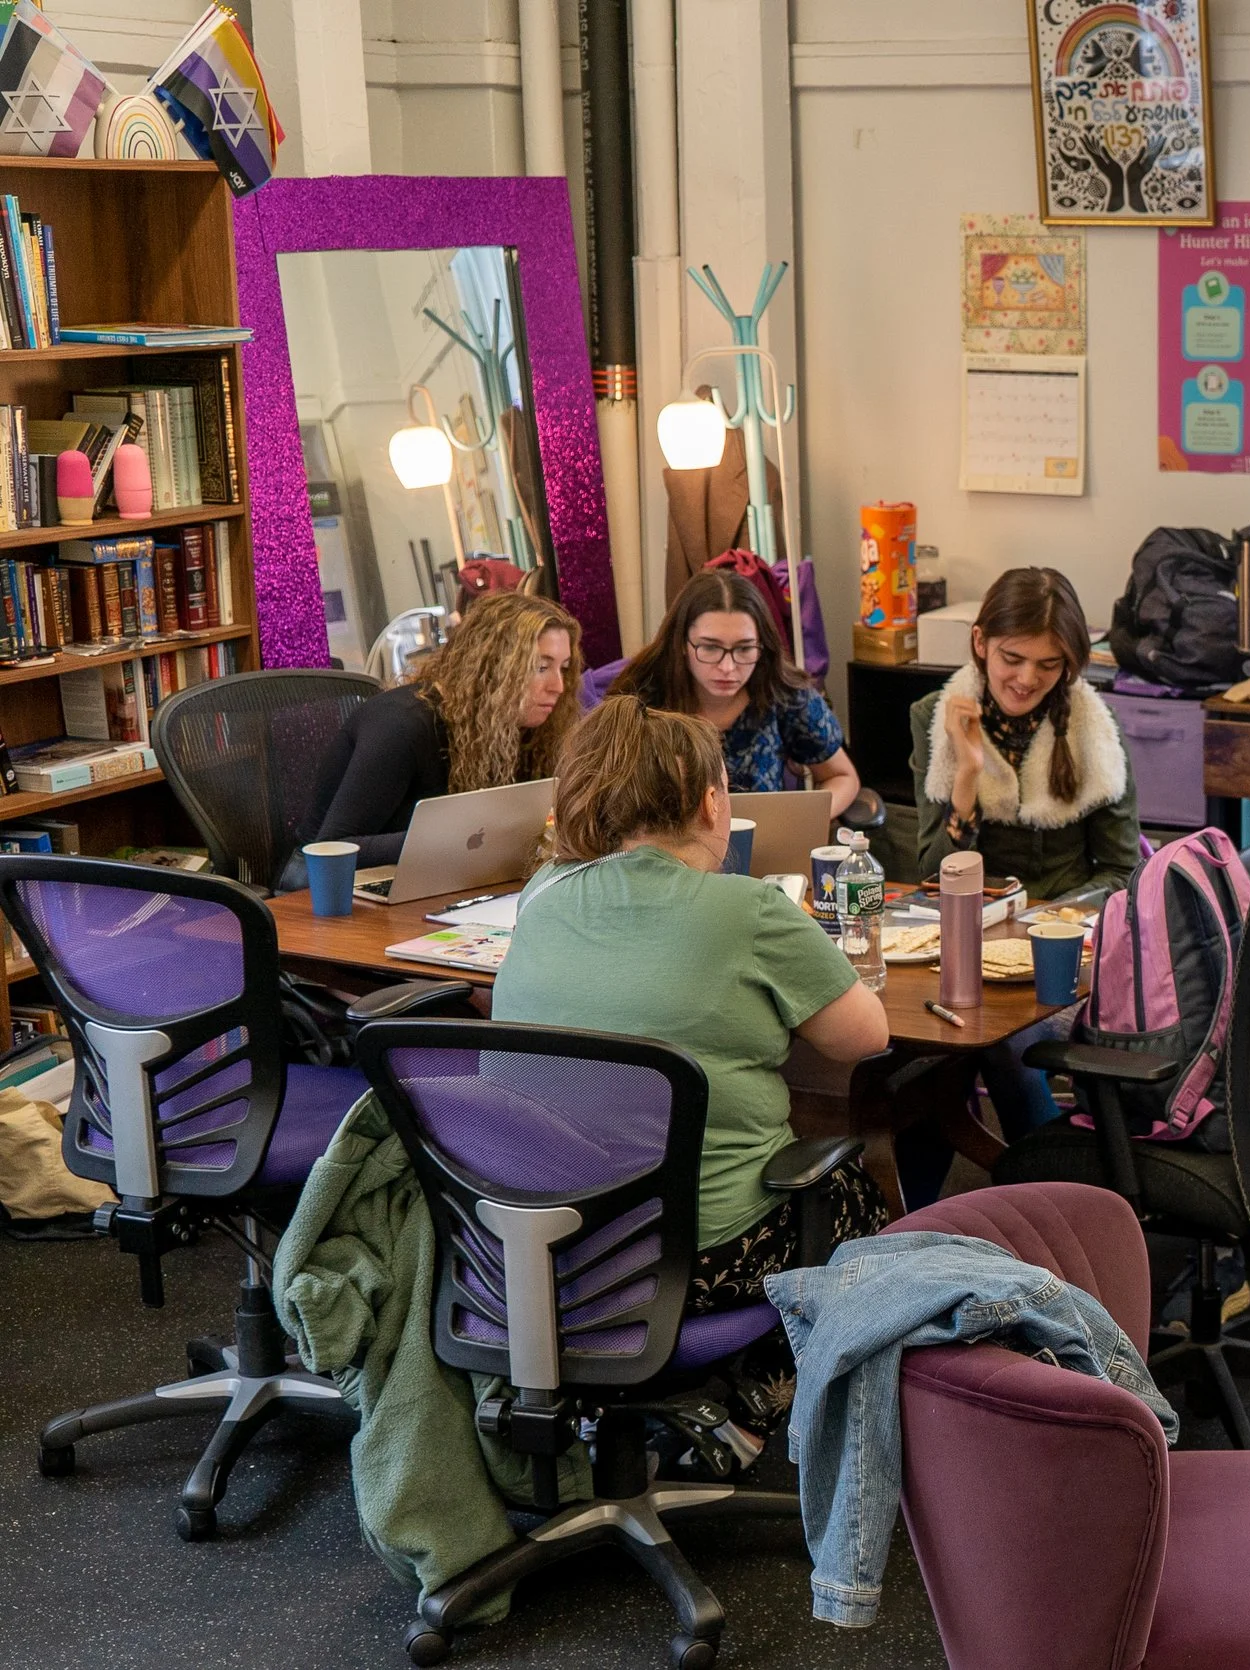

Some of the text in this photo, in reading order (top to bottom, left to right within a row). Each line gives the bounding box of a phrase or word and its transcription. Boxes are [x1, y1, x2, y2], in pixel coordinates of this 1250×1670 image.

[1099, 81, 1128, 98] את
[1131, 81, 1188, 102] פותח
[1067, 105, 1087, 120] חי
[1104, 125, 1142, 157] רצון
[229, 171, 246, 189] JQY
[1222, 216, 1240, 229] an
[1180, 234, 1230, 249] Hunter
[1201, 256, 1222, 266] Let's
[1224, 257, 1249, 266] make
[47, 250, 59, 321] THE TRIUMPH OF LIFE
[21, 445, 29, 487] OBSERVANT
[857, 884, 882, 899] Poland
[859, 892, 883, 908] Spring
